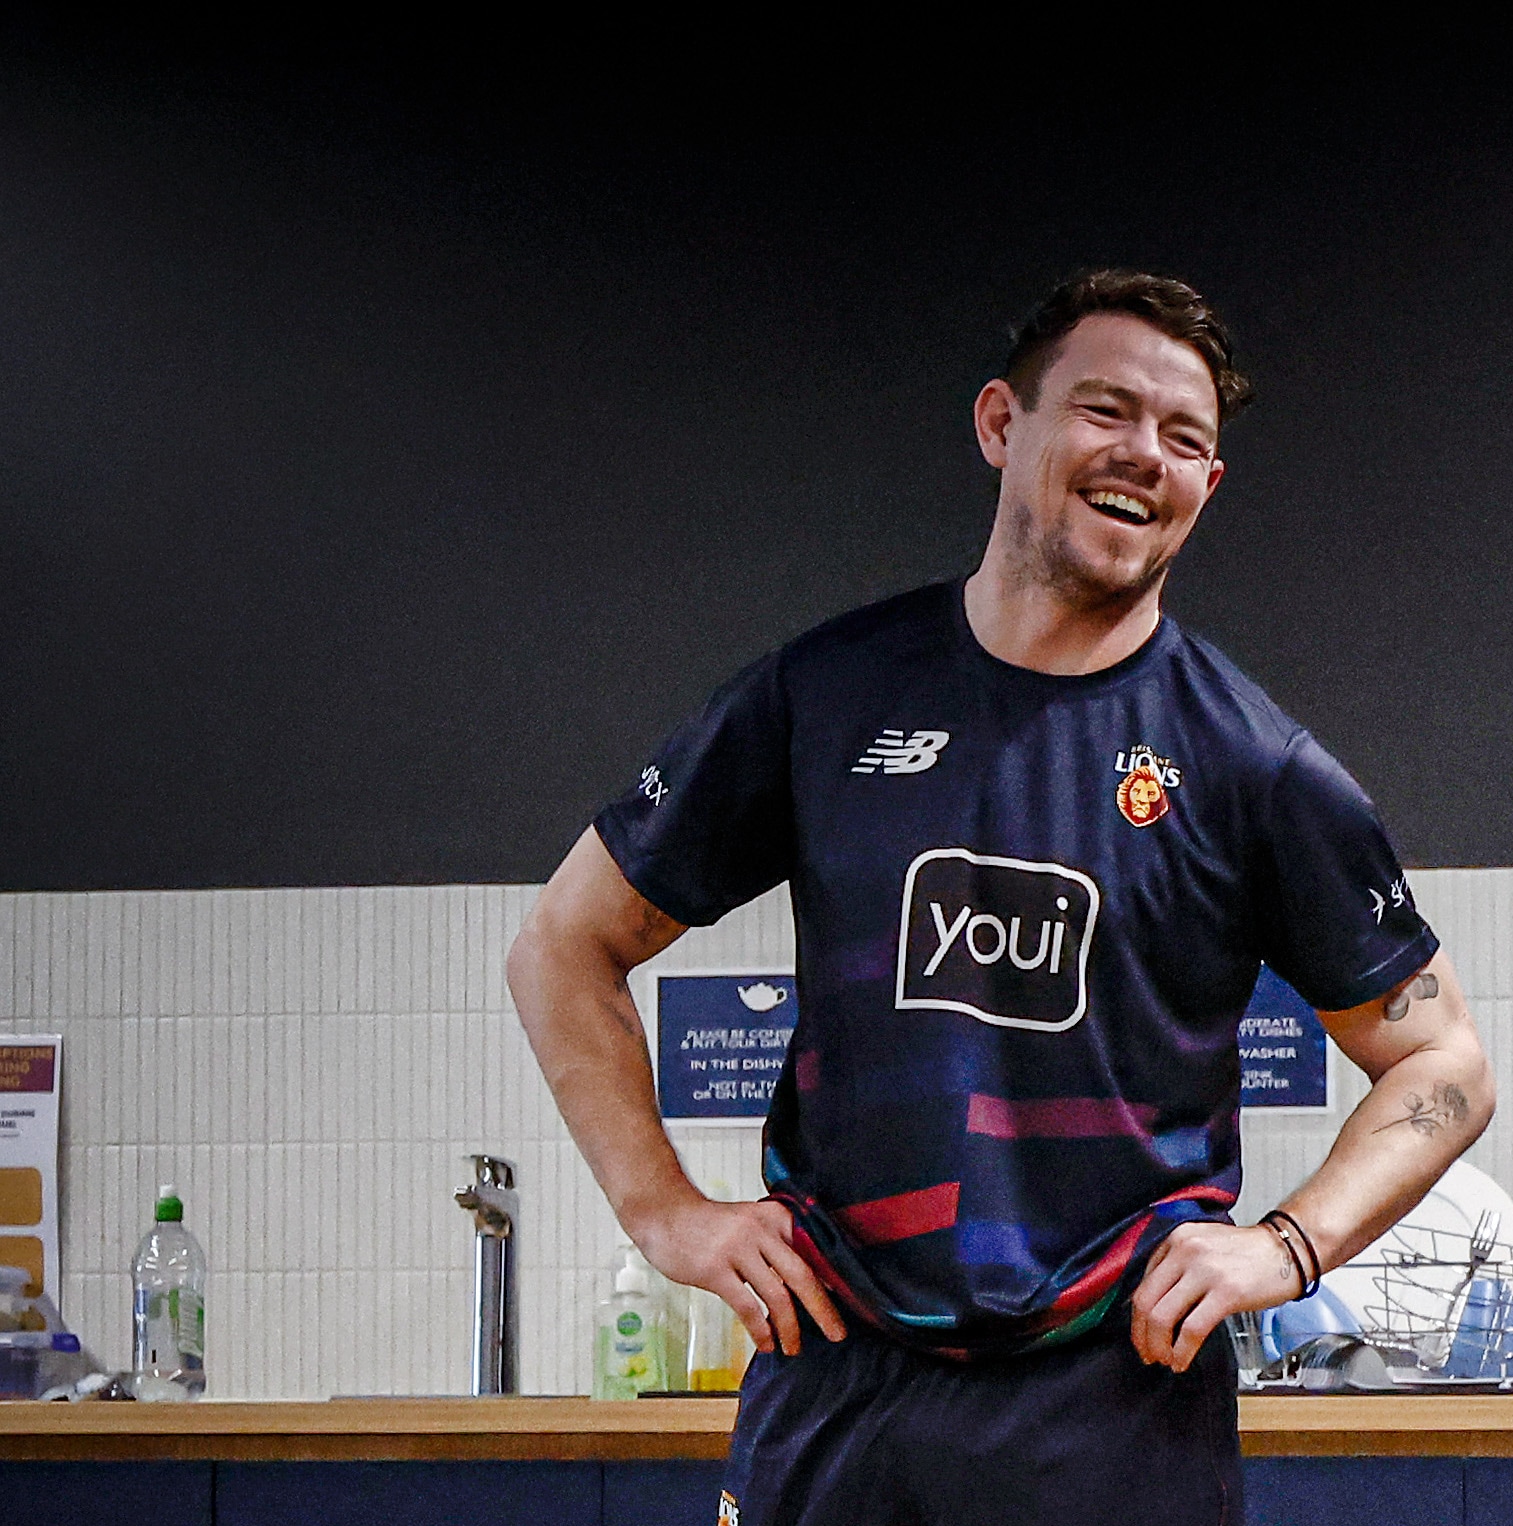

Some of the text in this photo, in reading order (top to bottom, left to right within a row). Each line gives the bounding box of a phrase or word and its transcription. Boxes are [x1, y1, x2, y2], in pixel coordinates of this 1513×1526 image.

[1114, 751, 1181, 788] LIONS
[923, 896, 1069, 976] youi
[690, 1059, 707, 1071] IN
[711, 1059, 739, 1070] THE
